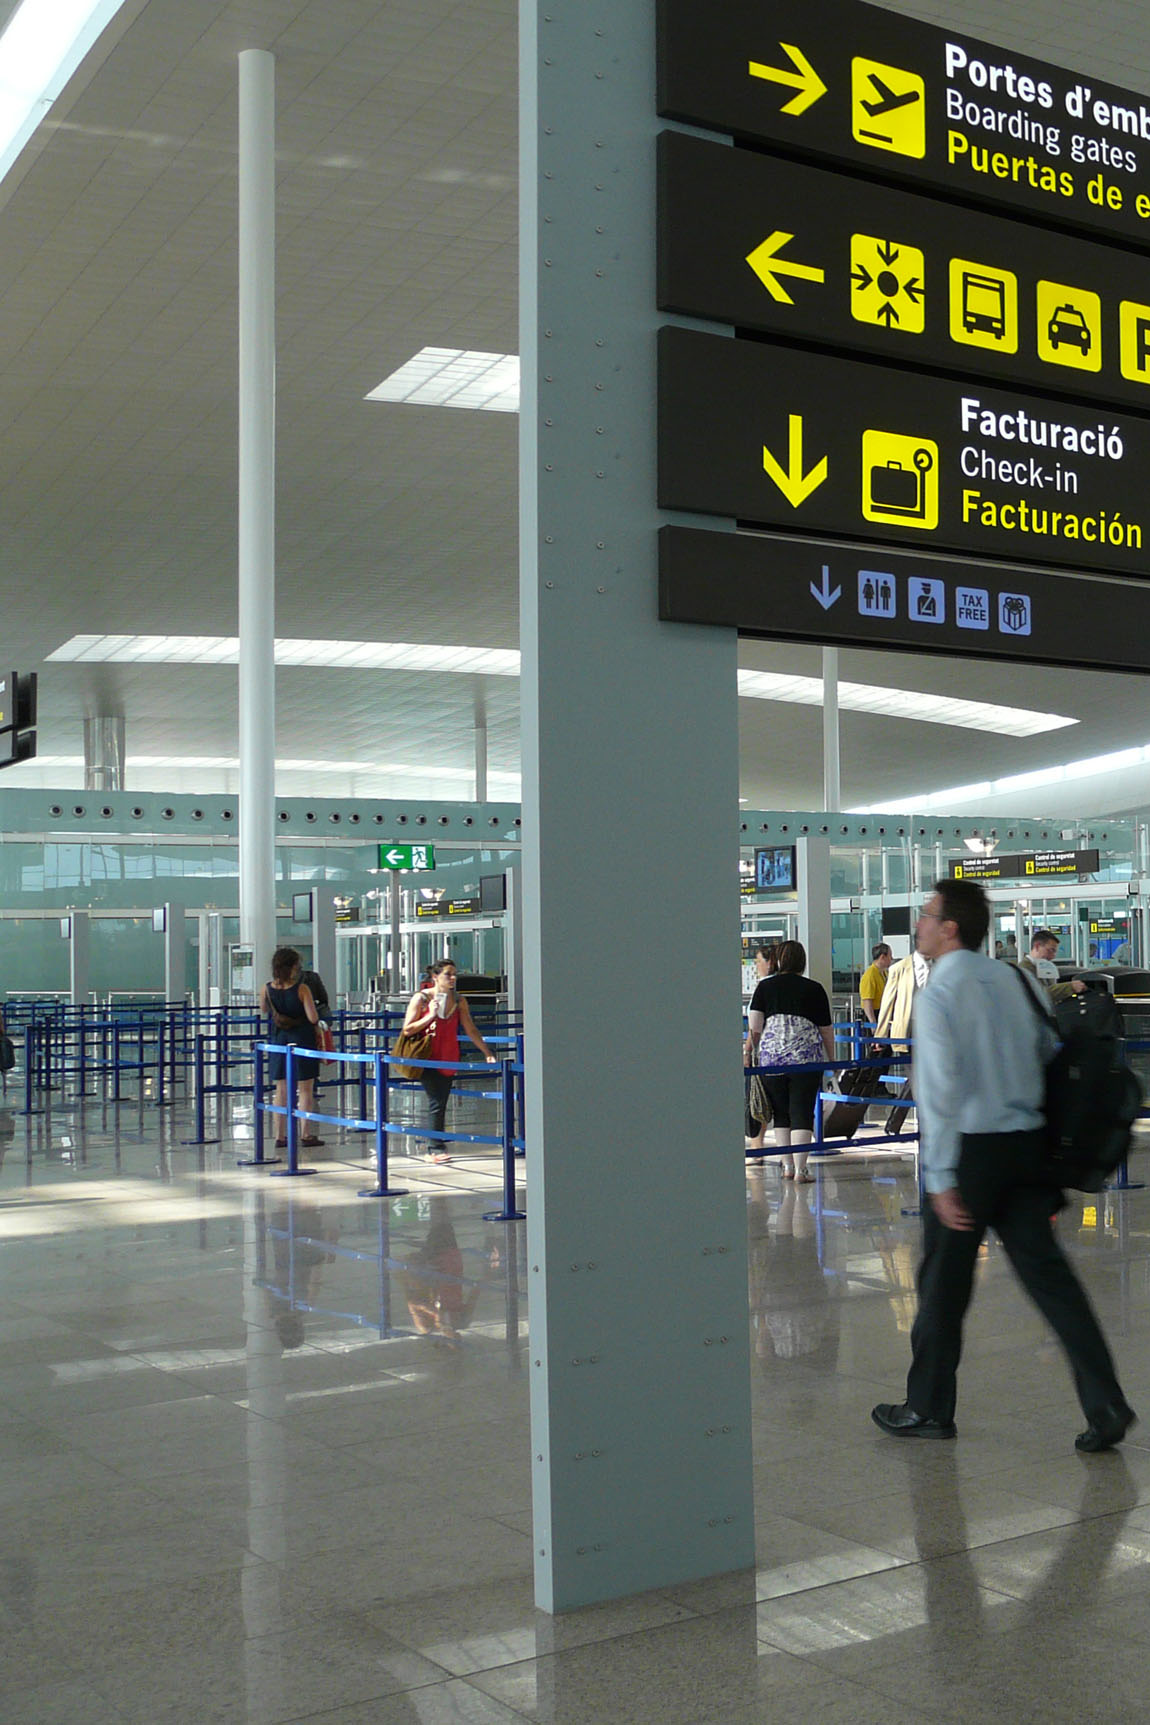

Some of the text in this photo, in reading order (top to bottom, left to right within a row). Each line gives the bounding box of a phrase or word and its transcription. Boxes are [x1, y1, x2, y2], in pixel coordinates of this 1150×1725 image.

[946, 43, 1053, 108] Portes
[947, 88, 1136, 172] Boarding gates
[948, 130, 1073, 196] Puertas
[1087, 174, 1122, 209] de
[961, 398, 1123, 459] Facturació
[961, 447, 1077, 493] Check-in
[963, 490, 1141, 548] Facturación
[958, 607, 986, 621] FREE
[962, 594, 983, 608] TAX
